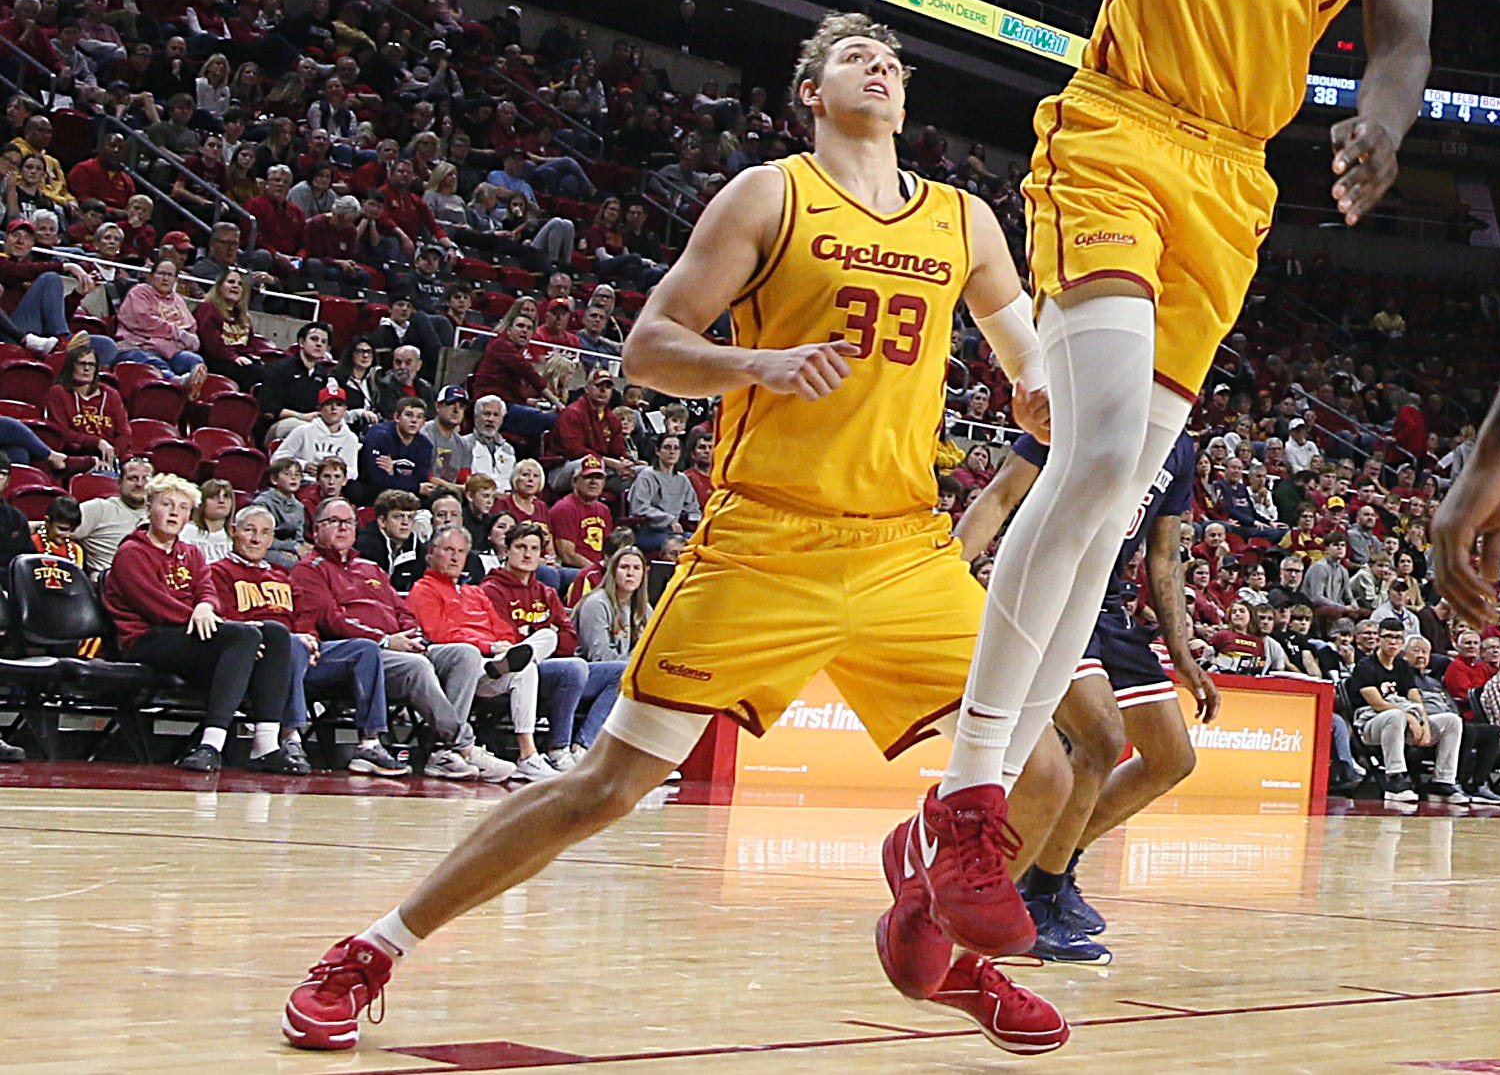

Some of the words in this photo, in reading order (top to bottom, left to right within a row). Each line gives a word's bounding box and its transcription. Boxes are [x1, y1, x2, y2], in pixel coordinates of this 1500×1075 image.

[955, 2, 989, 26] DEERE
[1306, 74, 1356, 90] EBOUNDS
[1313, 86, 1338, 106] 38
[1456, 94, 1476, 105] FLS
[1430, 101, 1443, 119] 3
[1458, 104, 1472, 123] 4
[1074, 230, 1138, 247] Cyclones
[810, 234, 953, 287] Cyclones
[828, 285, 928, 367] 33
[313, 442, 345, 457] NIKE
[33, 566, 74, 583] STATE
[1234, 637, 1258, 649] STATE
[657, 657, 714, 683] Cyclones
[778, 699, 835, 731] First
[1198, 724, 1272, 751] Interstate
[1271, 727, 1303, 752] Bank
